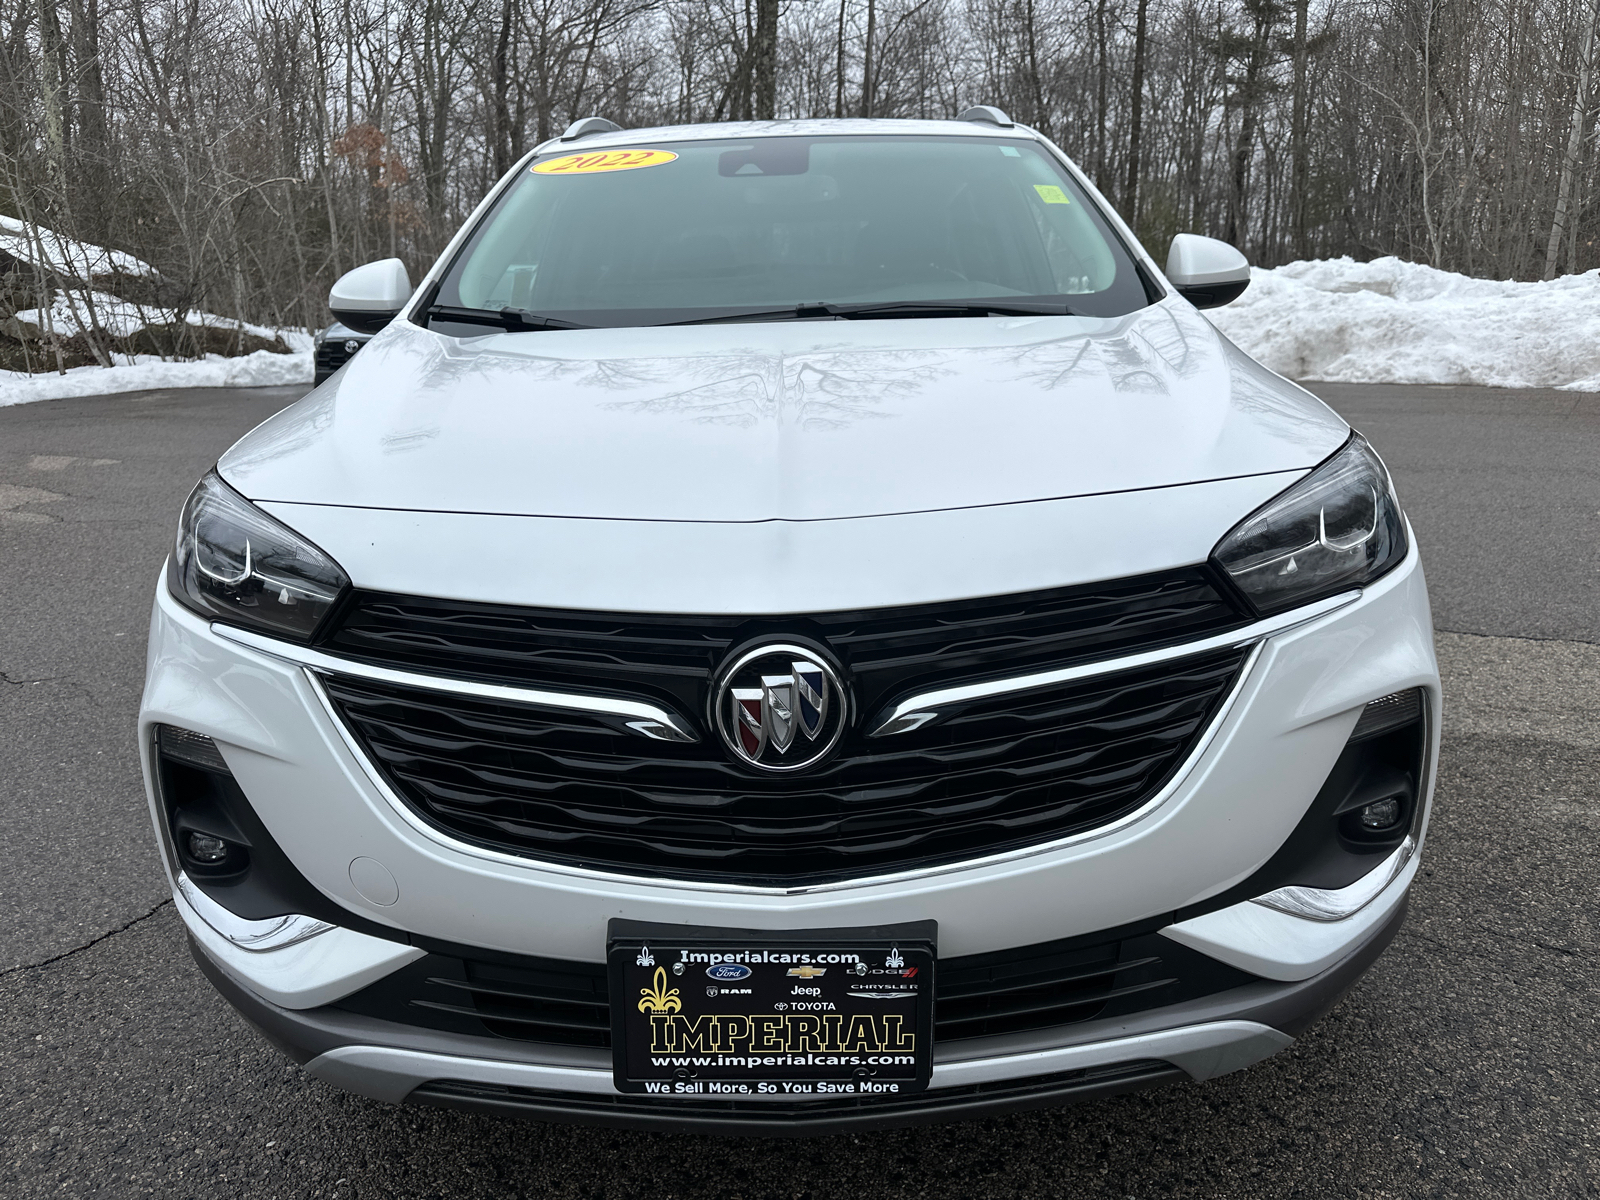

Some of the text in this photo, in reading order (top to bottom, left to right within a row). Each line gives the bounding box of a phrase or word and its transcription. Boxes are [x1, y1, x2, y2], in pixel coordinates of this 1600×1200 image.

[550, 152, 655, 171] 2022
[680, 950, 860, 966] Imperialcars.com
[716, 966, 741, 978] Ford
[790, 985, 821, 997] Jeep
[790, 1002, 836, 1011] TOYOTA
[650, 1014, 915, 1054] IMPERIAL
[650, 1053, 916, 1069] www.imperialcars.com
[645, 1082, 899, 1096] We Sell More, So You Save More
